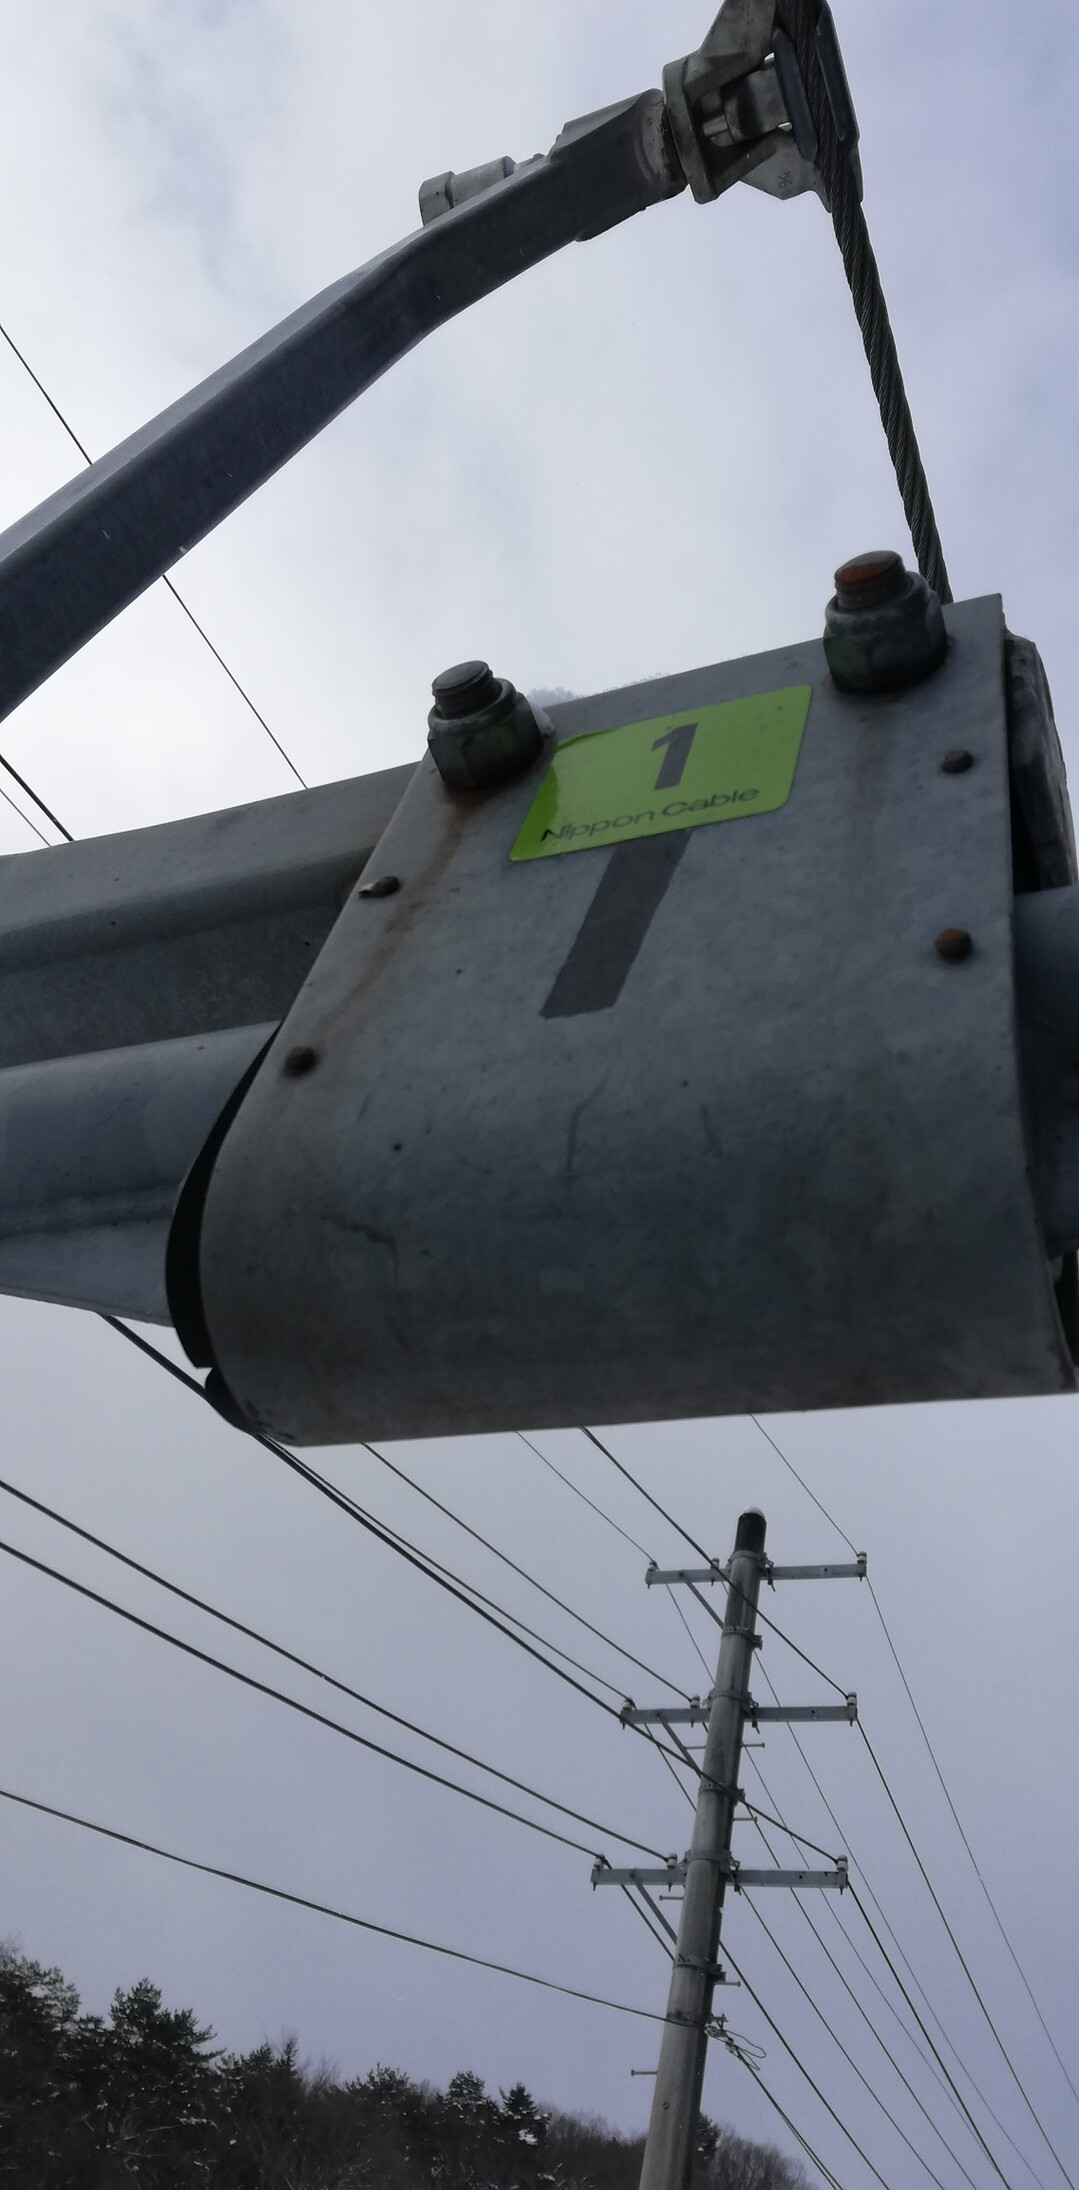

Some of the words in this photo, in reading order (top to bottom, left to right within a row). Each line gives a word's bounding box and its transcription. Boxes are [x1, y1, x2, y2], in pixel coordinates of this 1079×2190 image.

[651, 722, 699, 792] 1
[540, 810, 656, 842] Nippon
[661, 788, 760, 817] Cable
